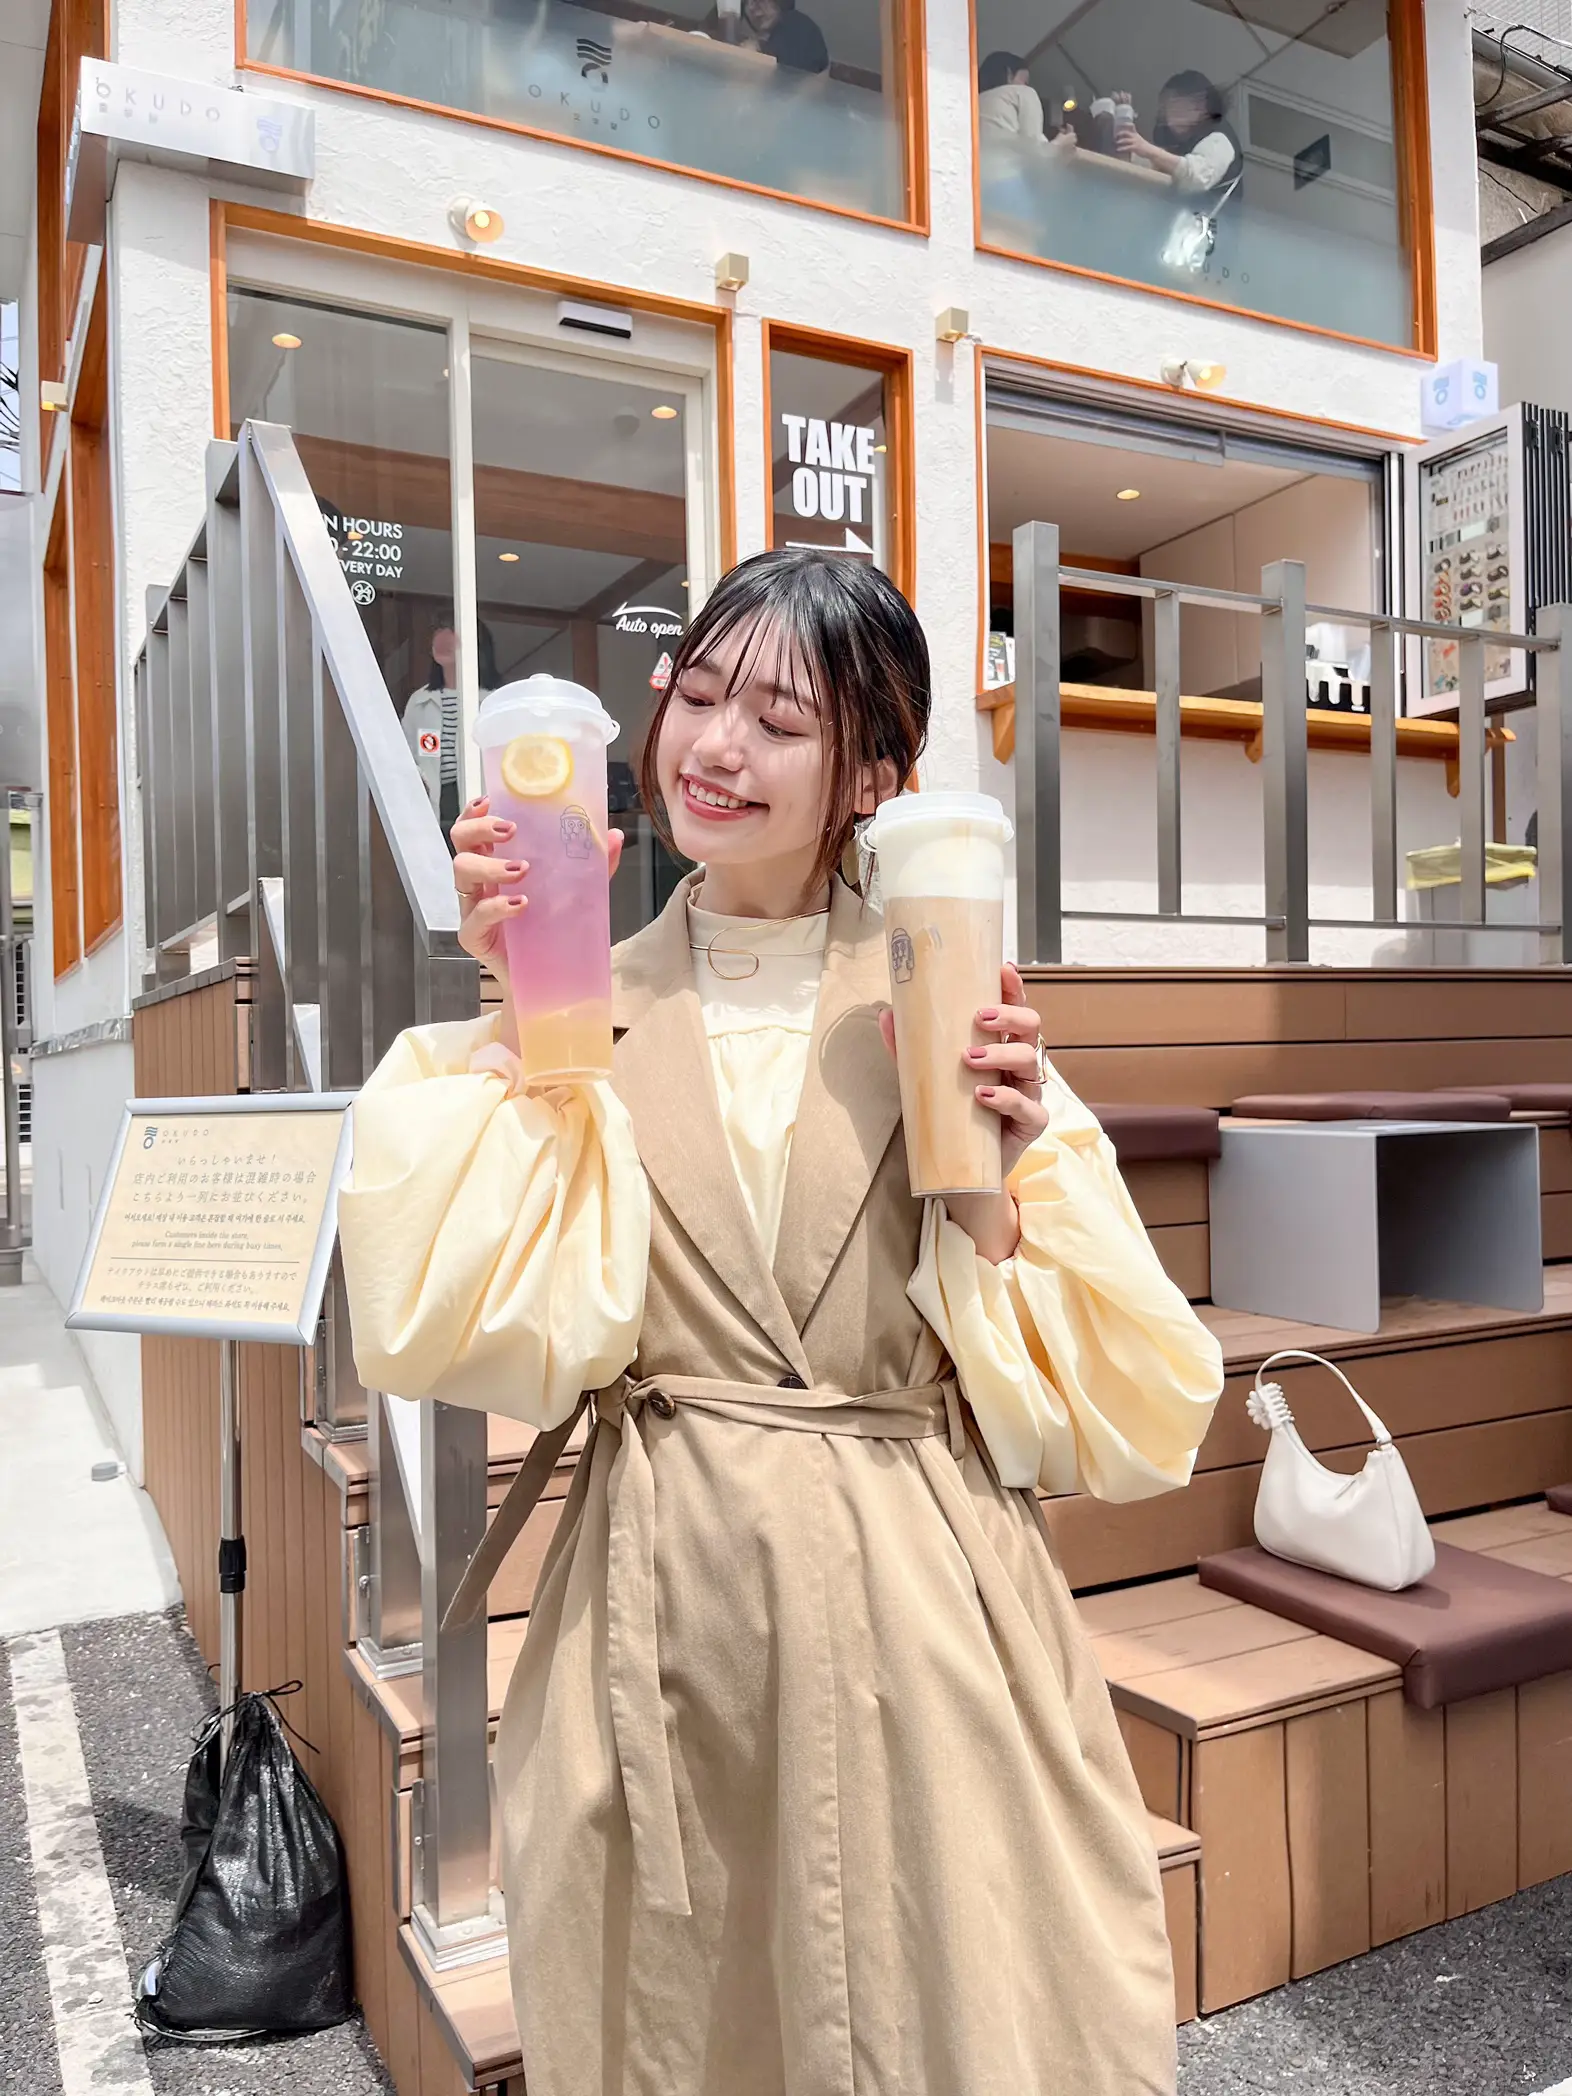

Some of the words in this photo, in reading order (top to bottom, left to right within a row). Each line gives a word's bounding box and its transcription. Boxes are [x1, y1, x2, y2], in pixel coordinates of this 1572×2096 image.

[96, 81, 221, 123] OKUDO
[528, 84, 660, 129] OKUDO
[781, 413, 876, 475] TAKE
[792, 467, 868, 523] OUT
[343, 516, 403, 540] HOURS
[351, 540, 402, 562] 22:00
[338, 560, 374, 576] VERY
[376, 564, 404, 579] DAY
[615, 614, 648, 634] Auto
[650, 622, 684, 640] open
